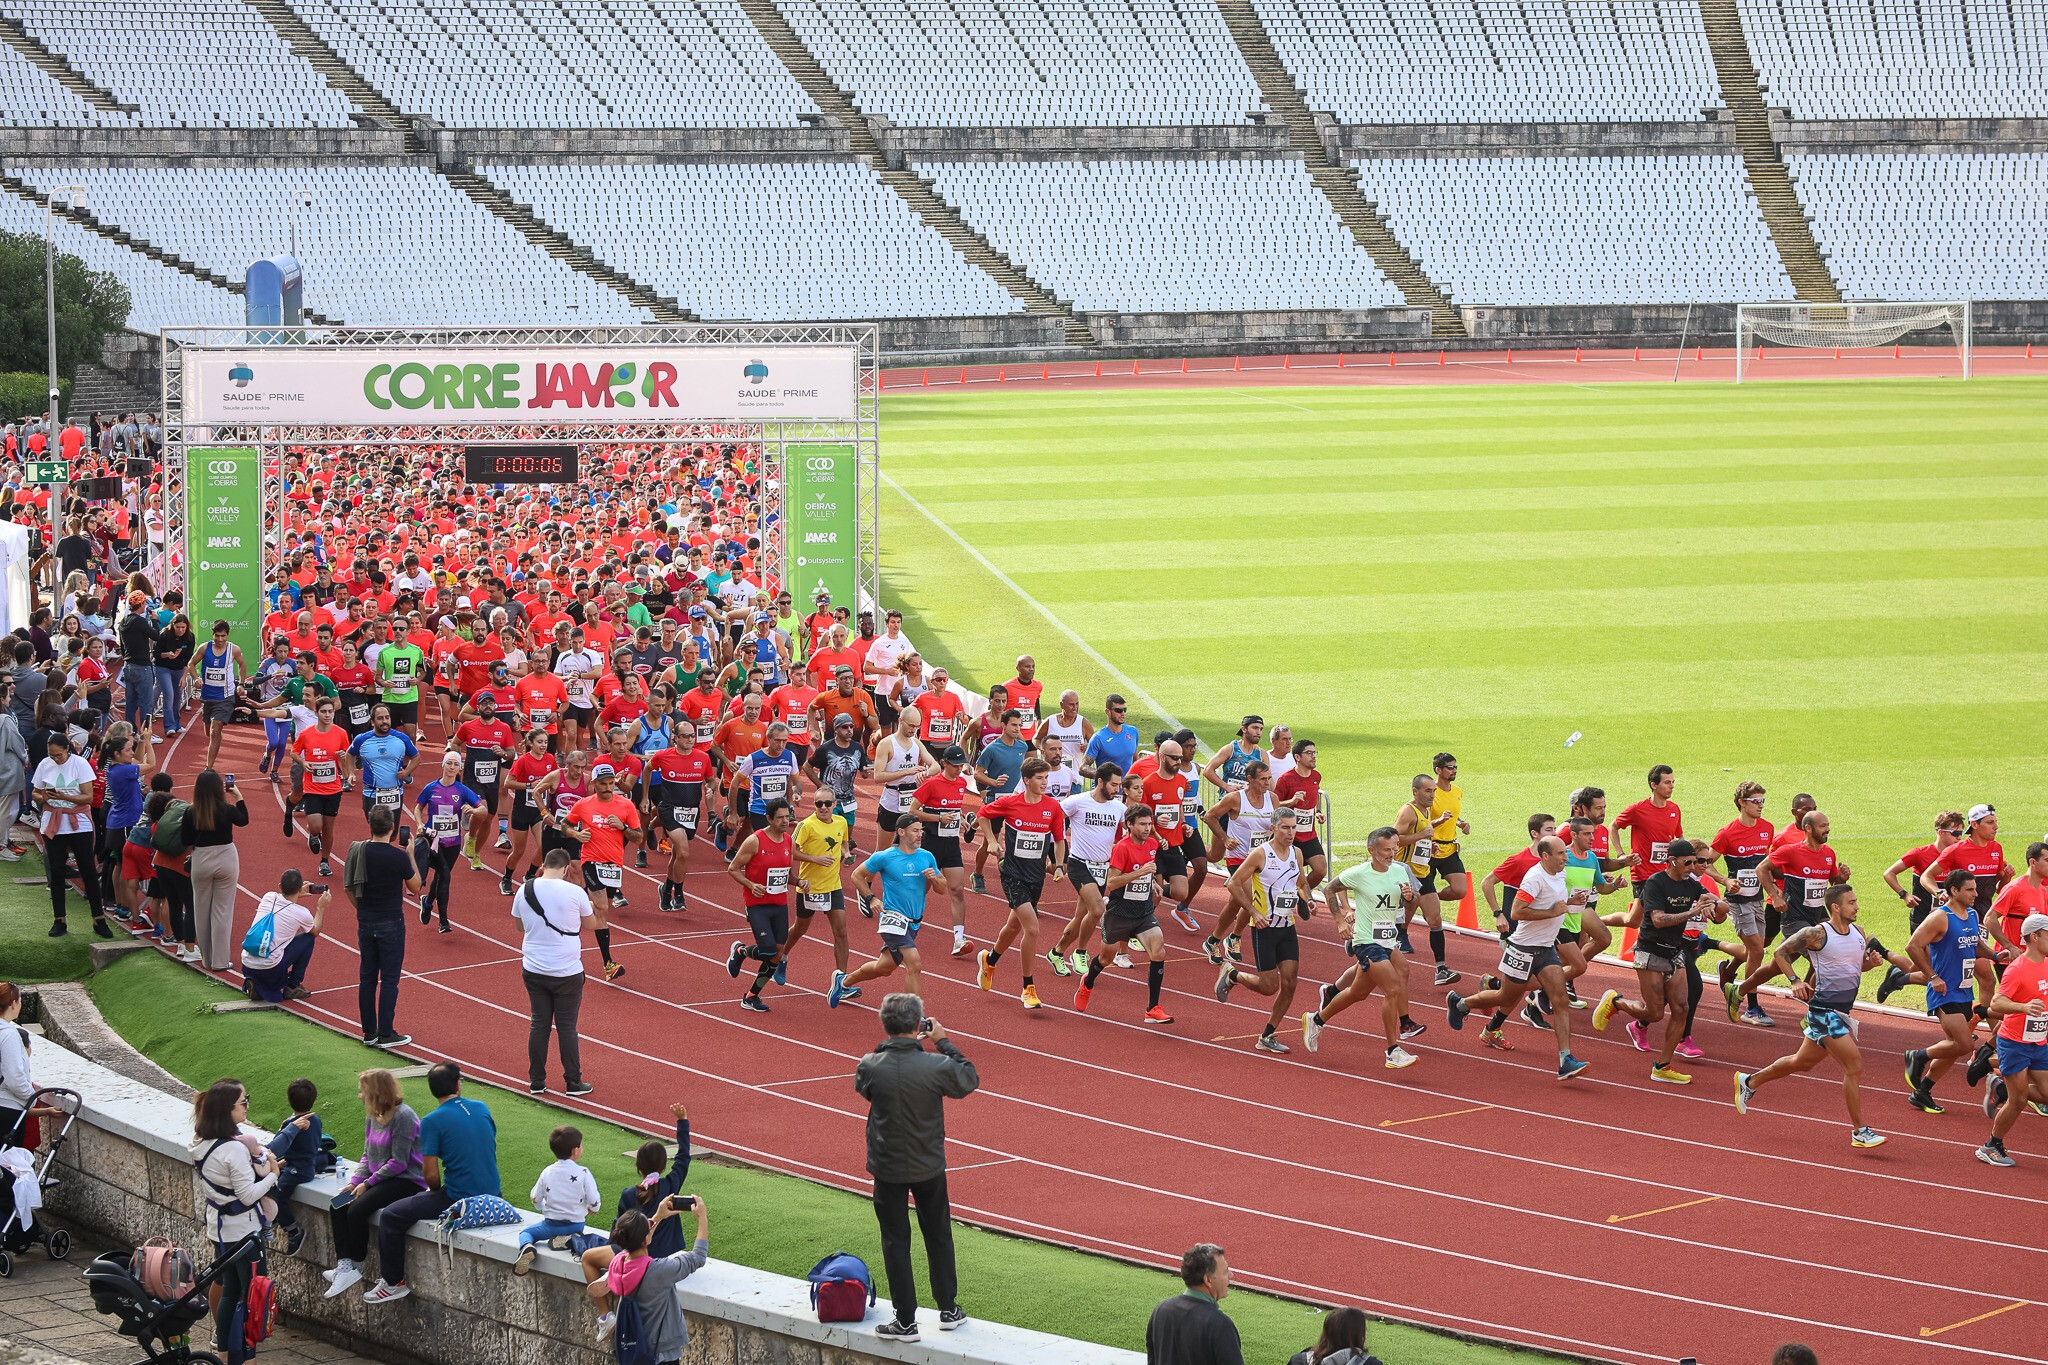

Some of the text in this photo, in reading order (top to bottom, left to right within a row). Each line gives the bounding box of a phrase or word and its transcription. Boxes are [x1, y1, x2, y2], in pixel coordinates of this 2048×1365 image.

[364, 362, 520, 410] CORRE
[223, 392, 305, 401] SAÚDE PRIME
[738, 389, 818, 398] SAÚDE PRIME
[495, 456, 563, 473] 0:00:06
[207, 514, 240, 522] VALLEY
[804, 510, 837, 518] VALLEY
[808, 557, 845, 565] outsystems
[211, 562, 249, 570] outsystems
[395, 659, 409, 668] GO
[208, 673, 222, 681] 408
[395, 680, 407, 688] 461
[354, 710, 367, 718] 865
[316, 768, 331, 776] 870
[480, 768, 494, 776] 820
[767, 784, 781, 792] 505
[381, 795, 396, 803] 809
[1085, 812, 1116, 821] BRUTAL
[1023, 821, 1049, 829] outsystem
[1022, 841, 1038, 849] 814
[601, 870, 617, 878] 898
[1743, 878, 1757, 887] 827
[1131, 883, 1148, 892] 836
[809, 893, 825, 902] 523
[1375, 893, 1396, 909] XL
[1284, 899, 1294, 907] 57
[1381, 929, 1393, 938] 60
[1507, 957, 1524, 970] 592
